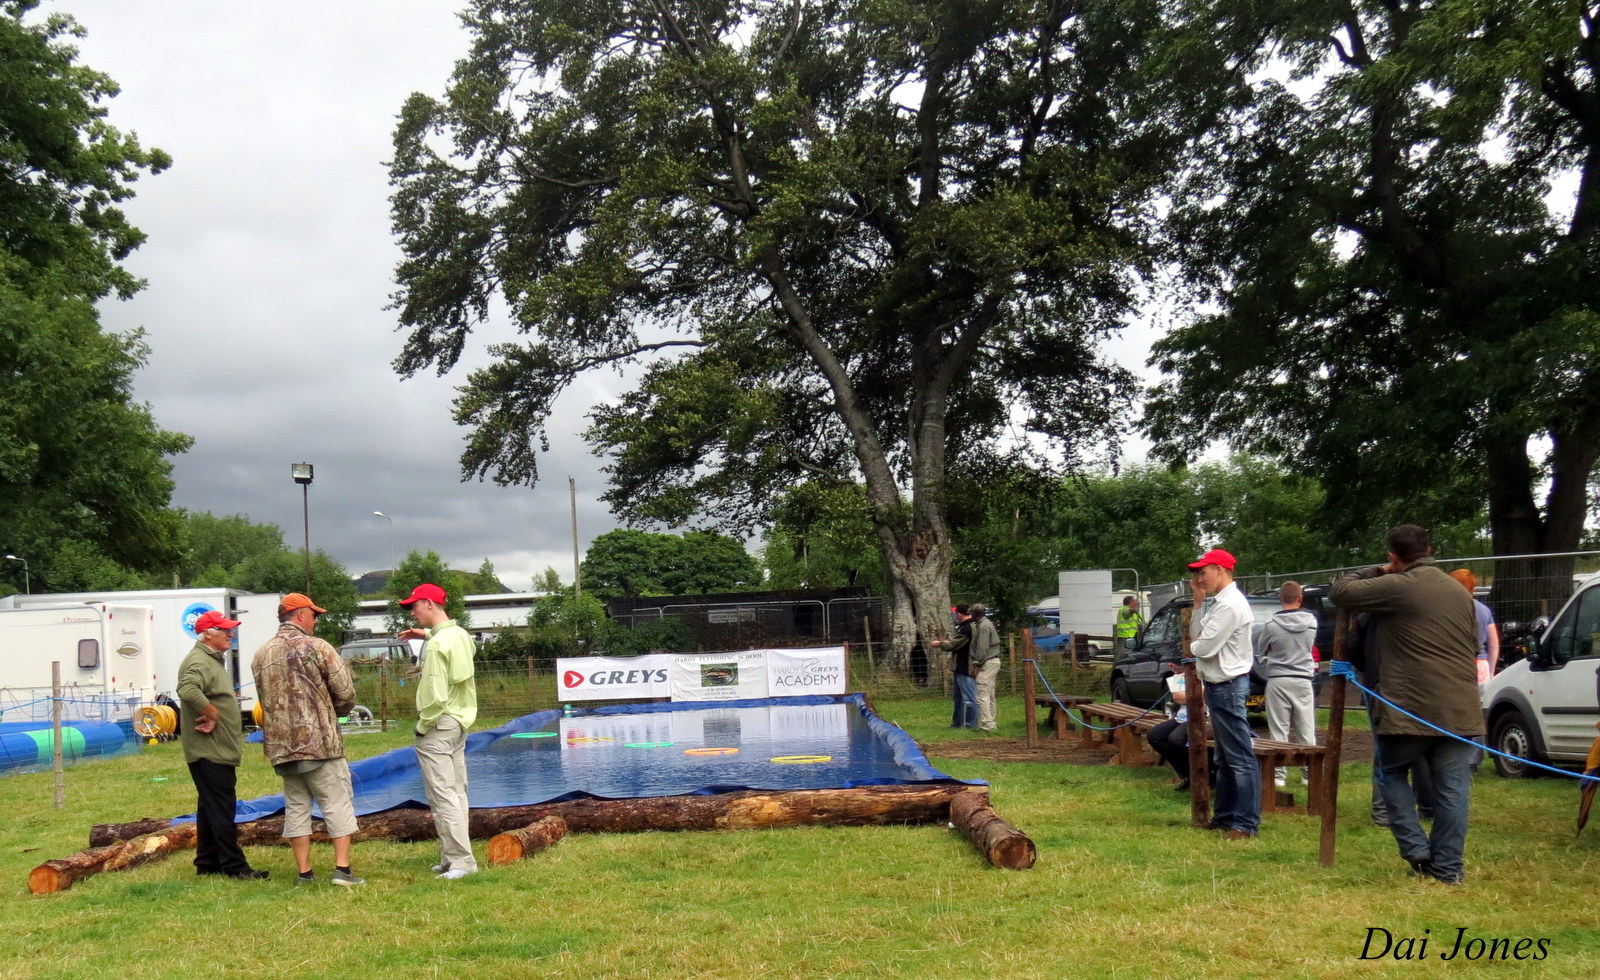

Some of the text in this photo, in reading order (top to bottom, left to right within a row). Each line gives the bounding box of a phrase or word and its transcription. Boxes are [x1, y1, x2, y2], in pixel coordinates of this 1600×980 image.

[811, 665, 839, 673] GREYS
[589, 668, 668, 685] GREYS
[775, 674, 839, 687] ACADEMY
